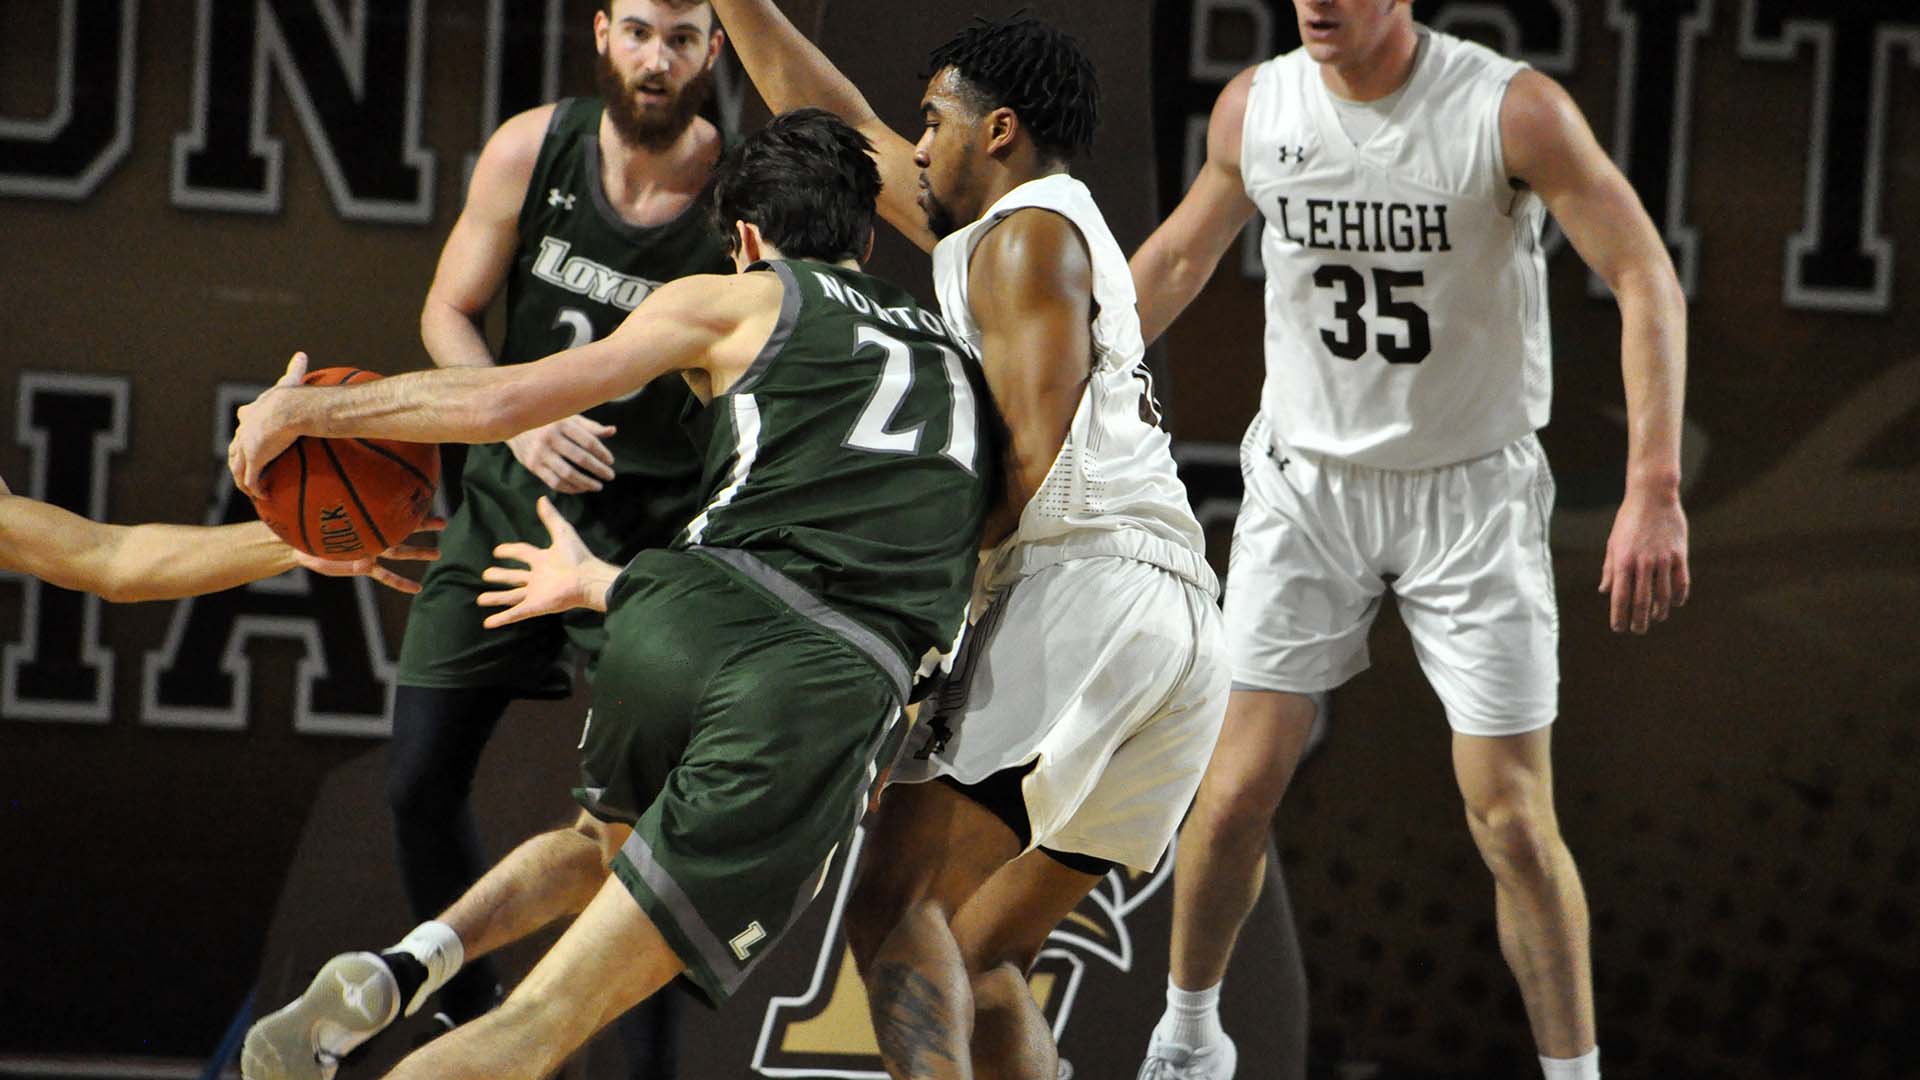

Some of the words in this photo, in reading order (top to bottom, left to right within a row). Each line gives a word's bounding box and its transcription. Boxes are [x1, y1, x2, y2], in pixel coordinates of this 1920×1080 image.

[1277, 196, 1452, 253] LEHIGH
[532, 235, 666, 312] LOYO
[1312, 264, 1432, 365] 35
[840, 320, 978, 478] 21
